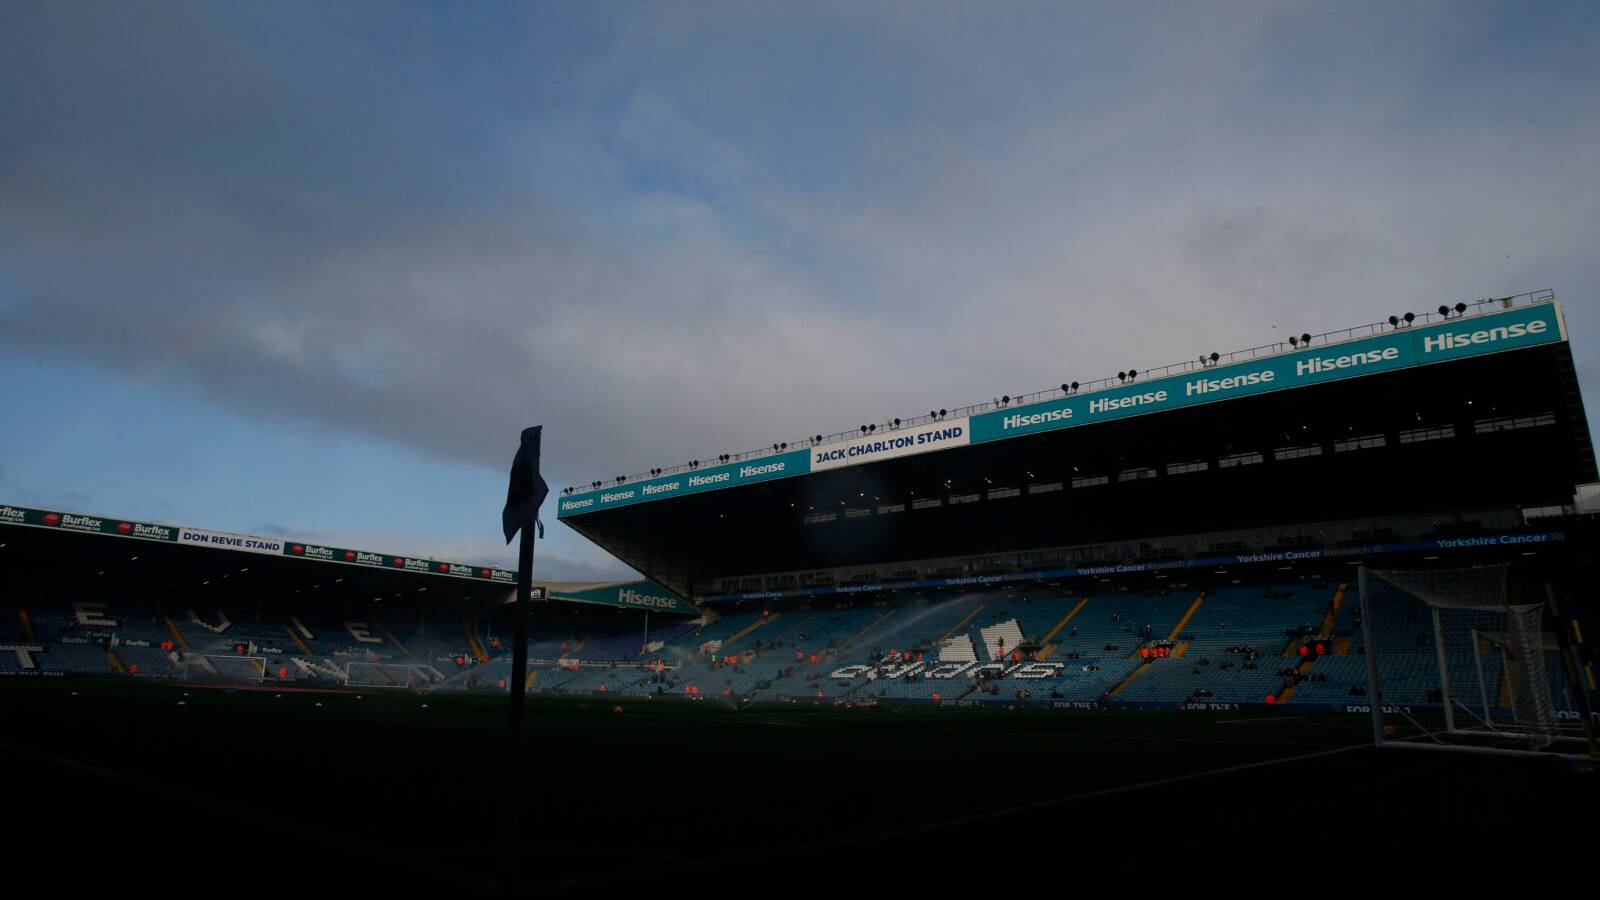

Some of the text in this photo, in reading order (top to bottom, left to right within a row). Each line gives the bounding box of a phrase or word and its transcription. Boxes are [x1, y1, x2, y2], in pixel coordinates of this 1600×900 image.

[1424, 319, 1547, 352] Hisense
[1296, 345, 1399, 376] Hisense
[1186, 370, 1275, 397] Hisense
[1089, 389, 1168, 415] Hisense
[1003, 407, 1073, 430] Hisense
[816, 427, 962, 464] JACK CHARLTON STAND
[739, 461, 785, 478] Hisense
[688, 471, 730, 487] Hisense
[642, 481, 680, 495] Hisense
[600, 489, 635, 504] Hisense
[561, 498, 594, 511] Hisense
[62, 514, 103, 527] Burflex
[134, 523, 171, 536] Burflex
[183, 532, 280, 551] DON REVIE STAND
[1437, 536, 1497, 549] Yorkshire
[1500, 533, 1547, 545] Cancer
[305, 545, 333, 556] Burflex
[357, 552, 383, 562] Burflex
[1237, 552, 1284, 564] Yorkshire
[1285, 549, 1321, 559] Cancer
[405, 558, 430, 568] Burflex
[449, 563, 473, 573] Burflex
[1077, 566, 1116, 576] Yorkshire
[1116, 564, 1146, 573] Cancer
[491, 569, 513, 578] Burflex
[618, 589, 677, 609] Hisense
